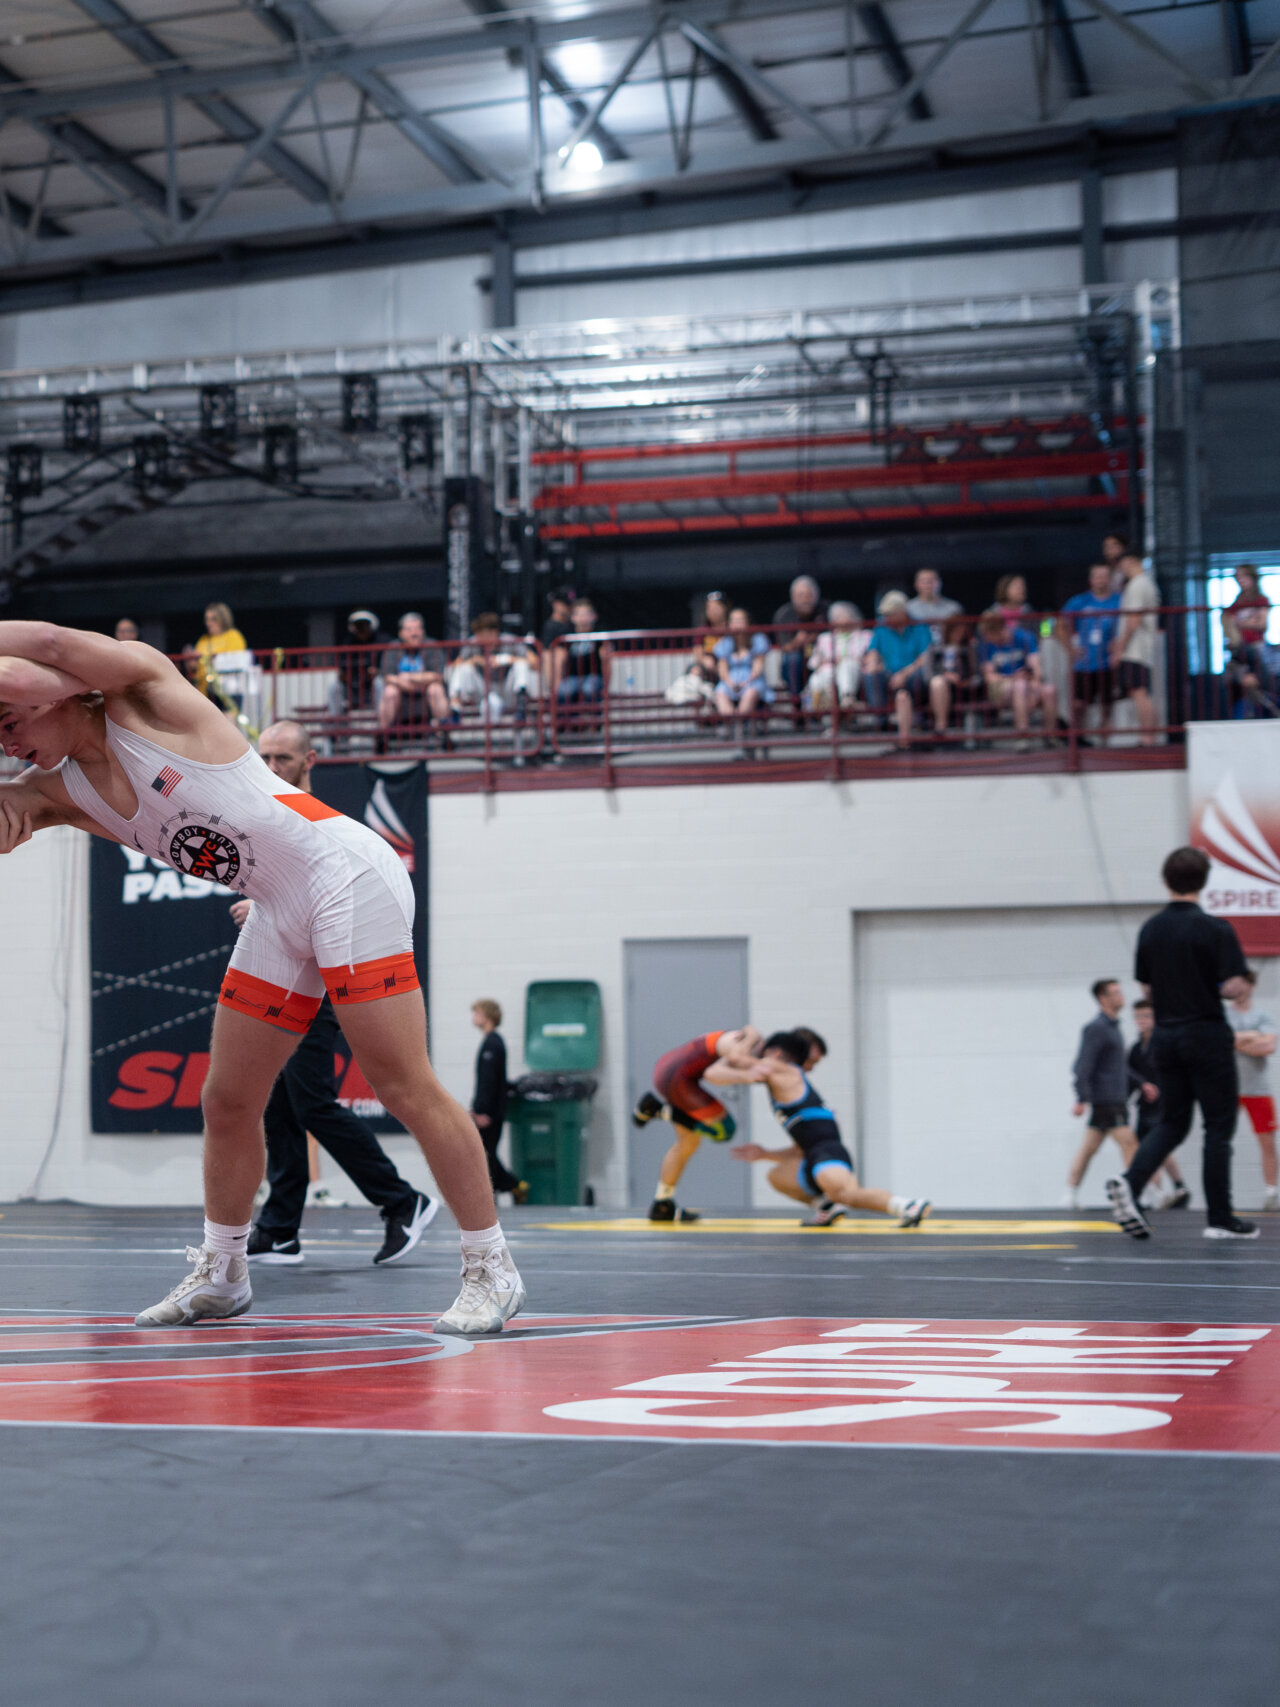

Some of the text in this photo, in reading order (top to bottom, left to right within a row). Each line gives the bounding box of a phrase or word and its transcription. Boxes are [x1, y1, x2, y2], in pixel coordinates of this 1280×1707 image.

[171, 827, 198, 866] COWBOY
[191, 841, 217, 876] CWC
[209, 832, 237, 855] CLUB
[1206, 889, 1279, 910] SPIRE
[541, 1323, 1271, 1436] SPIRE
